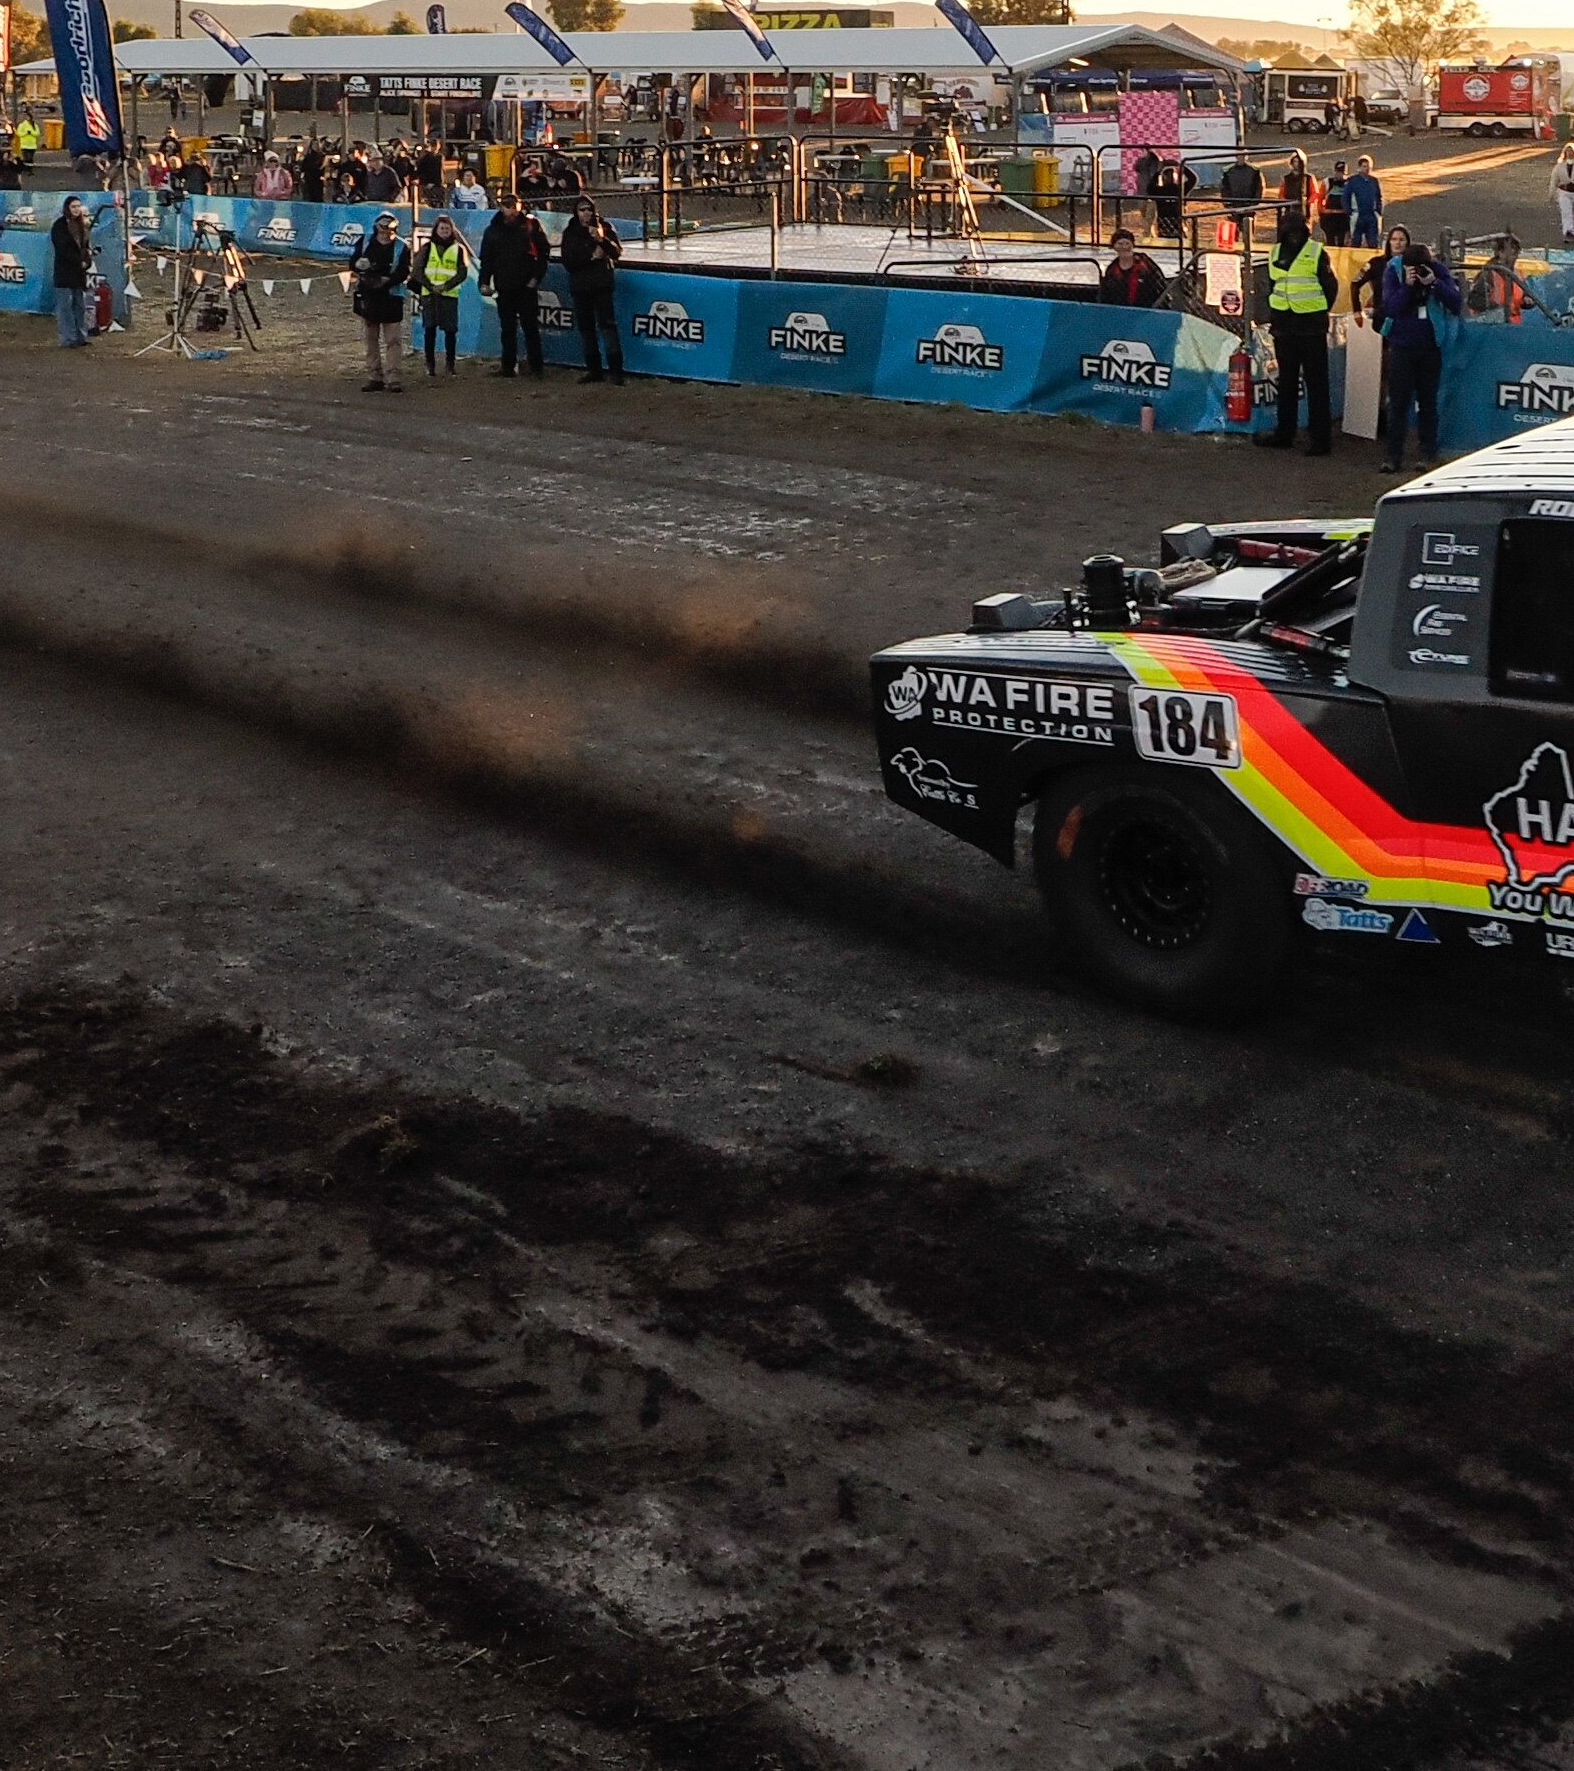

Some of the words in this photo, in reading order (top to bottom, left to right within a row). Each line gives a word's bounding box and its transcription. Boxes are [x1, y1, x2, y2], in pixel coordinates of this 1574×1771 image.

[257, 227, 297, 242] FINKE
[633, 317, 703, 340] FINKE
[769, 329, 846, 354] FINKE
[917, 340, 1002, 368] FINKE
[1081, 357, 1172, 388] FINKE
[892, 685, 917, 703] WA
[929, 672, 998, 709] WA
[1004, 681, 1116, 721] FIRE
[932, 707, 1113, 742] PROTECTION
[1137, 694, 1232, 761] 184
[1489, 884, 1544, 916] You
[1336, 909, 1388, 930] Tatts
